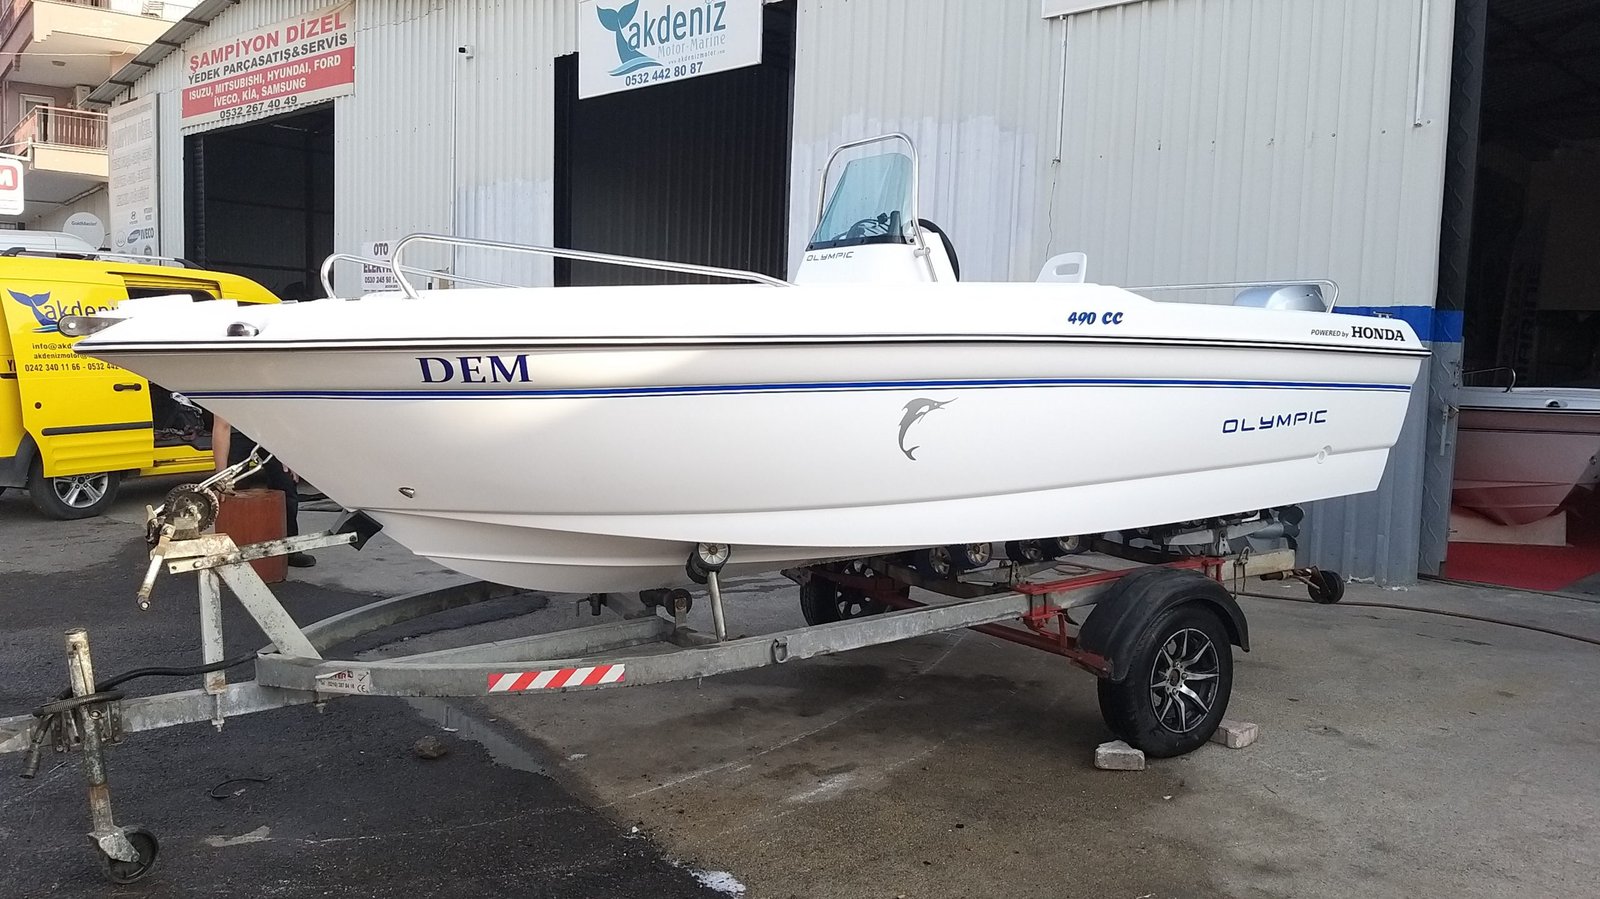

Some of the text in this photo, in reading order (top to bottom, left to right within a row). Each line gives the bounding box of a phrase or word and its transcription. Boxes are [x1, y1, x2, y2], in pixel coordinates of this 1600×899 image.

[628, 0, 727, 50] akdeniz
[190, 12, 347, 73] ŞAMPİYON DİZEL
[314, 55, 341, 70] FORD
[188, 68, 220, 85] YEDEK
[625, 61, 704, 86] 0532 442 80 87
[261, 78, 307, 97] SAMSUNG
[220, 95, 298, 118] 0532 267 40 49
[141, 227, 154, 240] IVECO
[374, 242, 389, 256] OTO
[806, 251, 854, 261] OLYMPIC
[1067, 312, 1123, 326] 490 CC
[1351, 326, 1405, 341] HONDA
[415, 354, 533, 383] DEM
[1222, 410, 1327, 433] OLYMPIC
